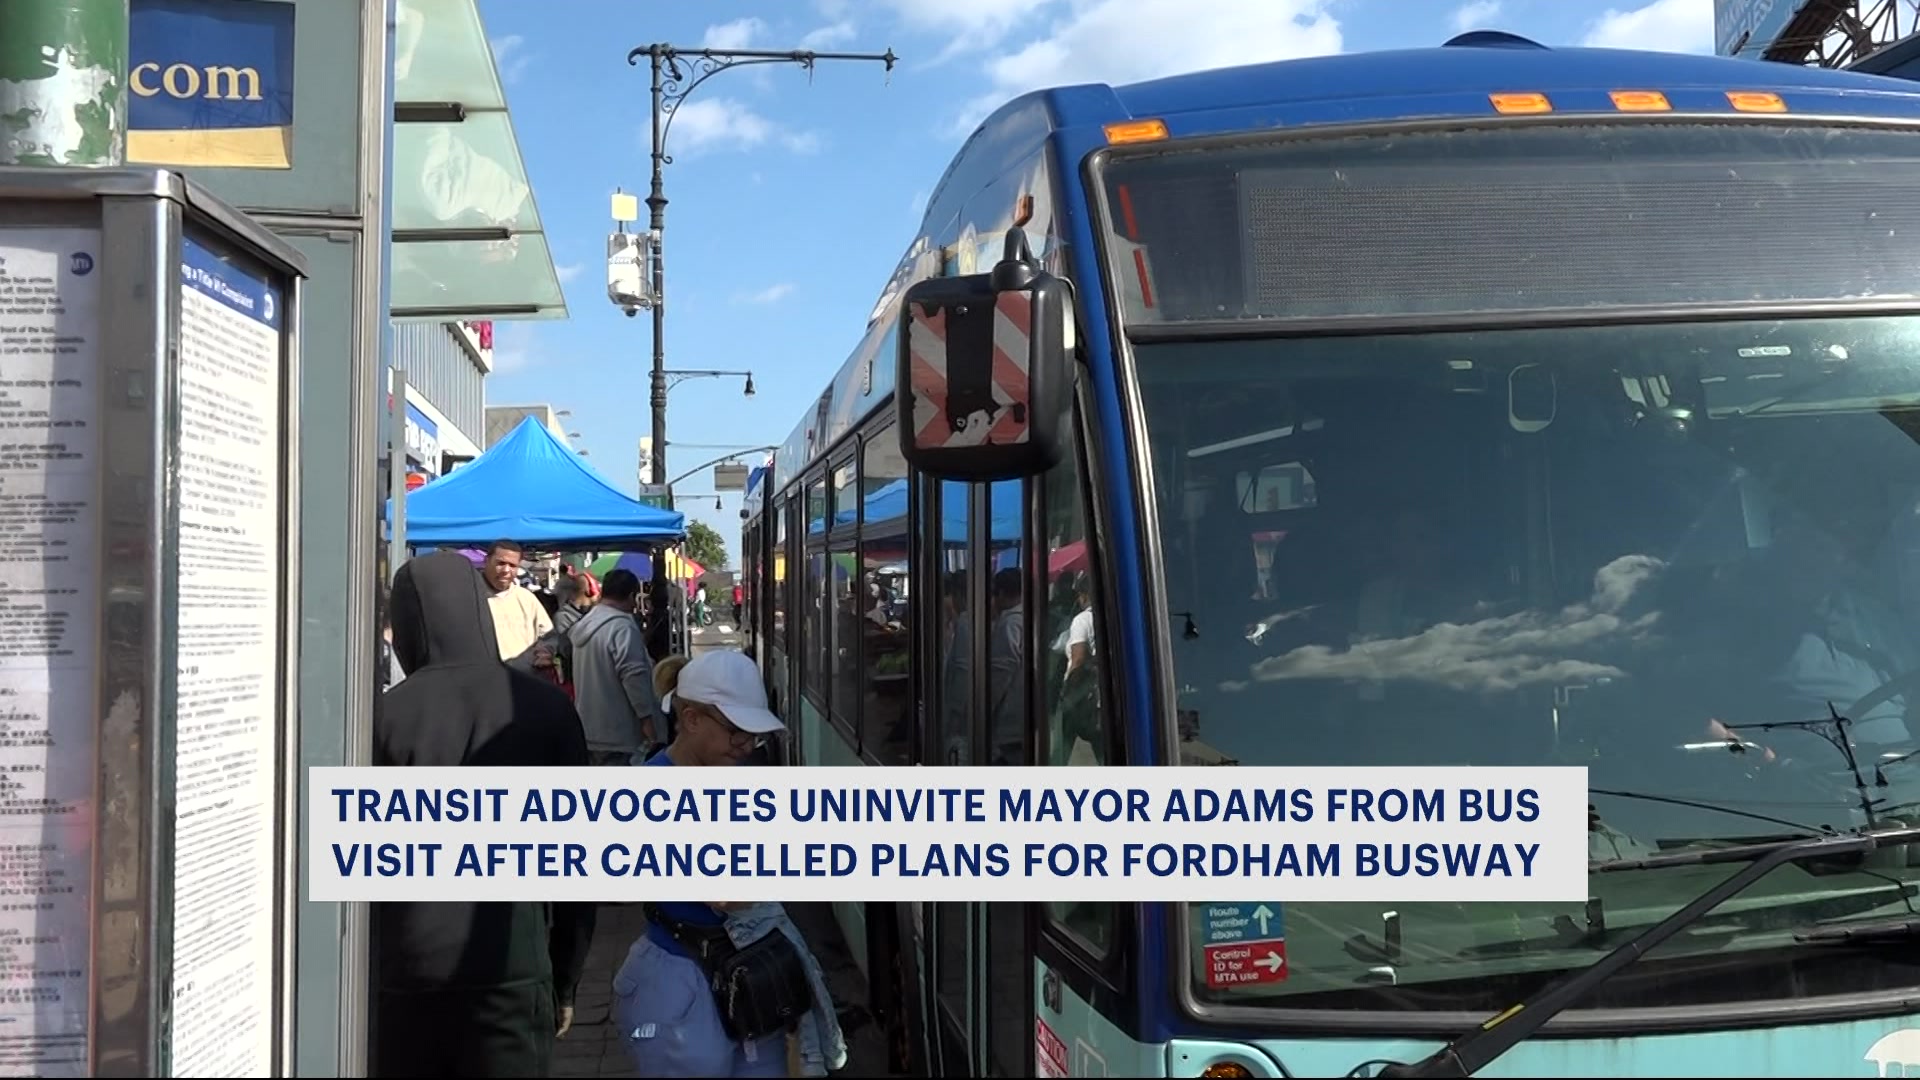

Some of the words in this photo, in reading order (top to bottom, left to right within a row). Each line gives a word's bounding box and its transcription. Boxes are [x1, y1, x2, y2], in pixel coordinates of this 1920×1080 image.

[130, 62, 263, 100] com
[1209, 906, 1239, 917] Route
[1210, 918, 1249, 929] number
[1211, 930, 1242, 940] above
[1213, 948, 1251, 960] Control
[1213, 961, 1226, 972] ID
[1229, 961, 1243, 970] for
[1214, 973, 1238, 982] MTA
[1240, 972, 1259, 981] use
